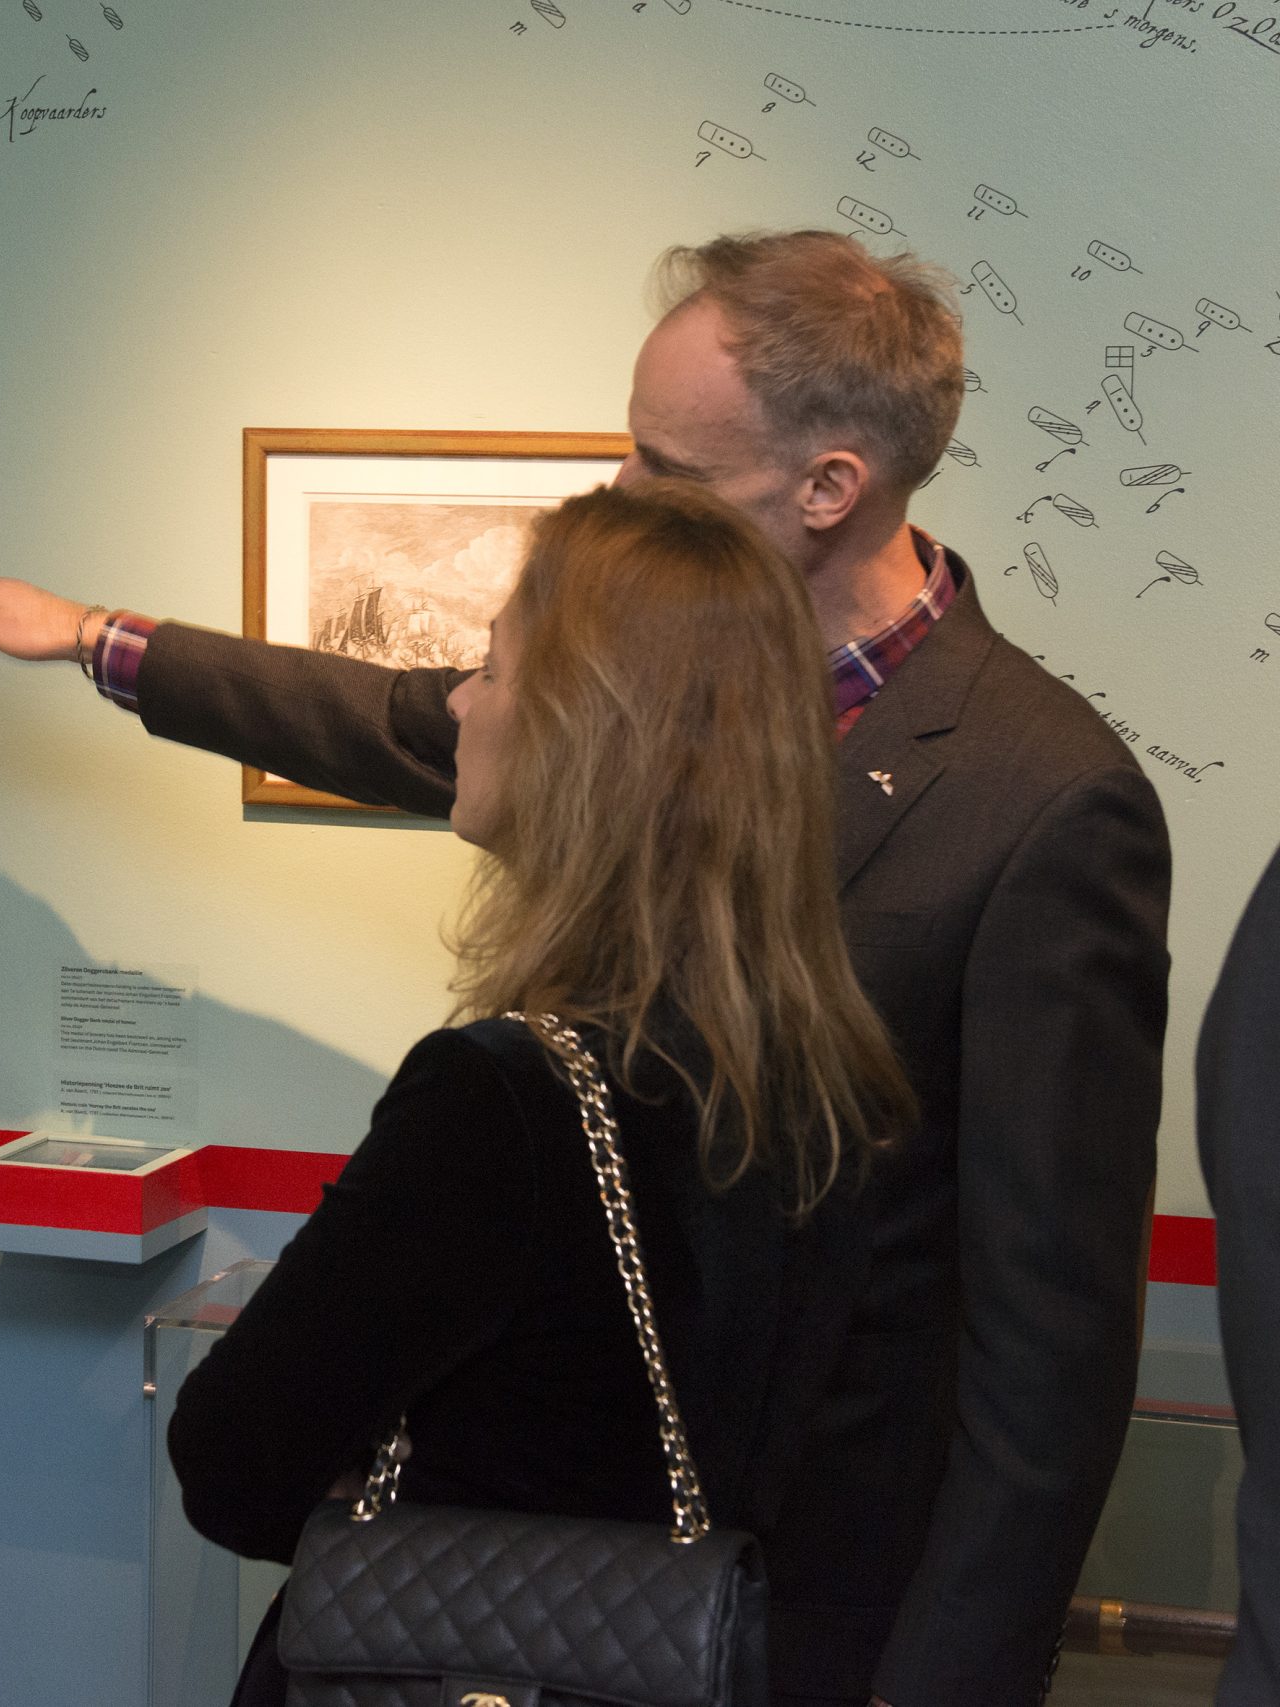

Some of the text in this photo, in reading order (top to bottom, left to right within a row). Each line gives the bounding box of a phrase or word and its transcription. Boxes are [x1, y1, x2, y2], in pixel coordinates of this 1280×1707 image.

[1123, 15, 1198, 53] morgens.
[761, 102, 777, 113] 8
[1140, 345, 1157, 358] 3
[1248, 647, 1271, 663] m
